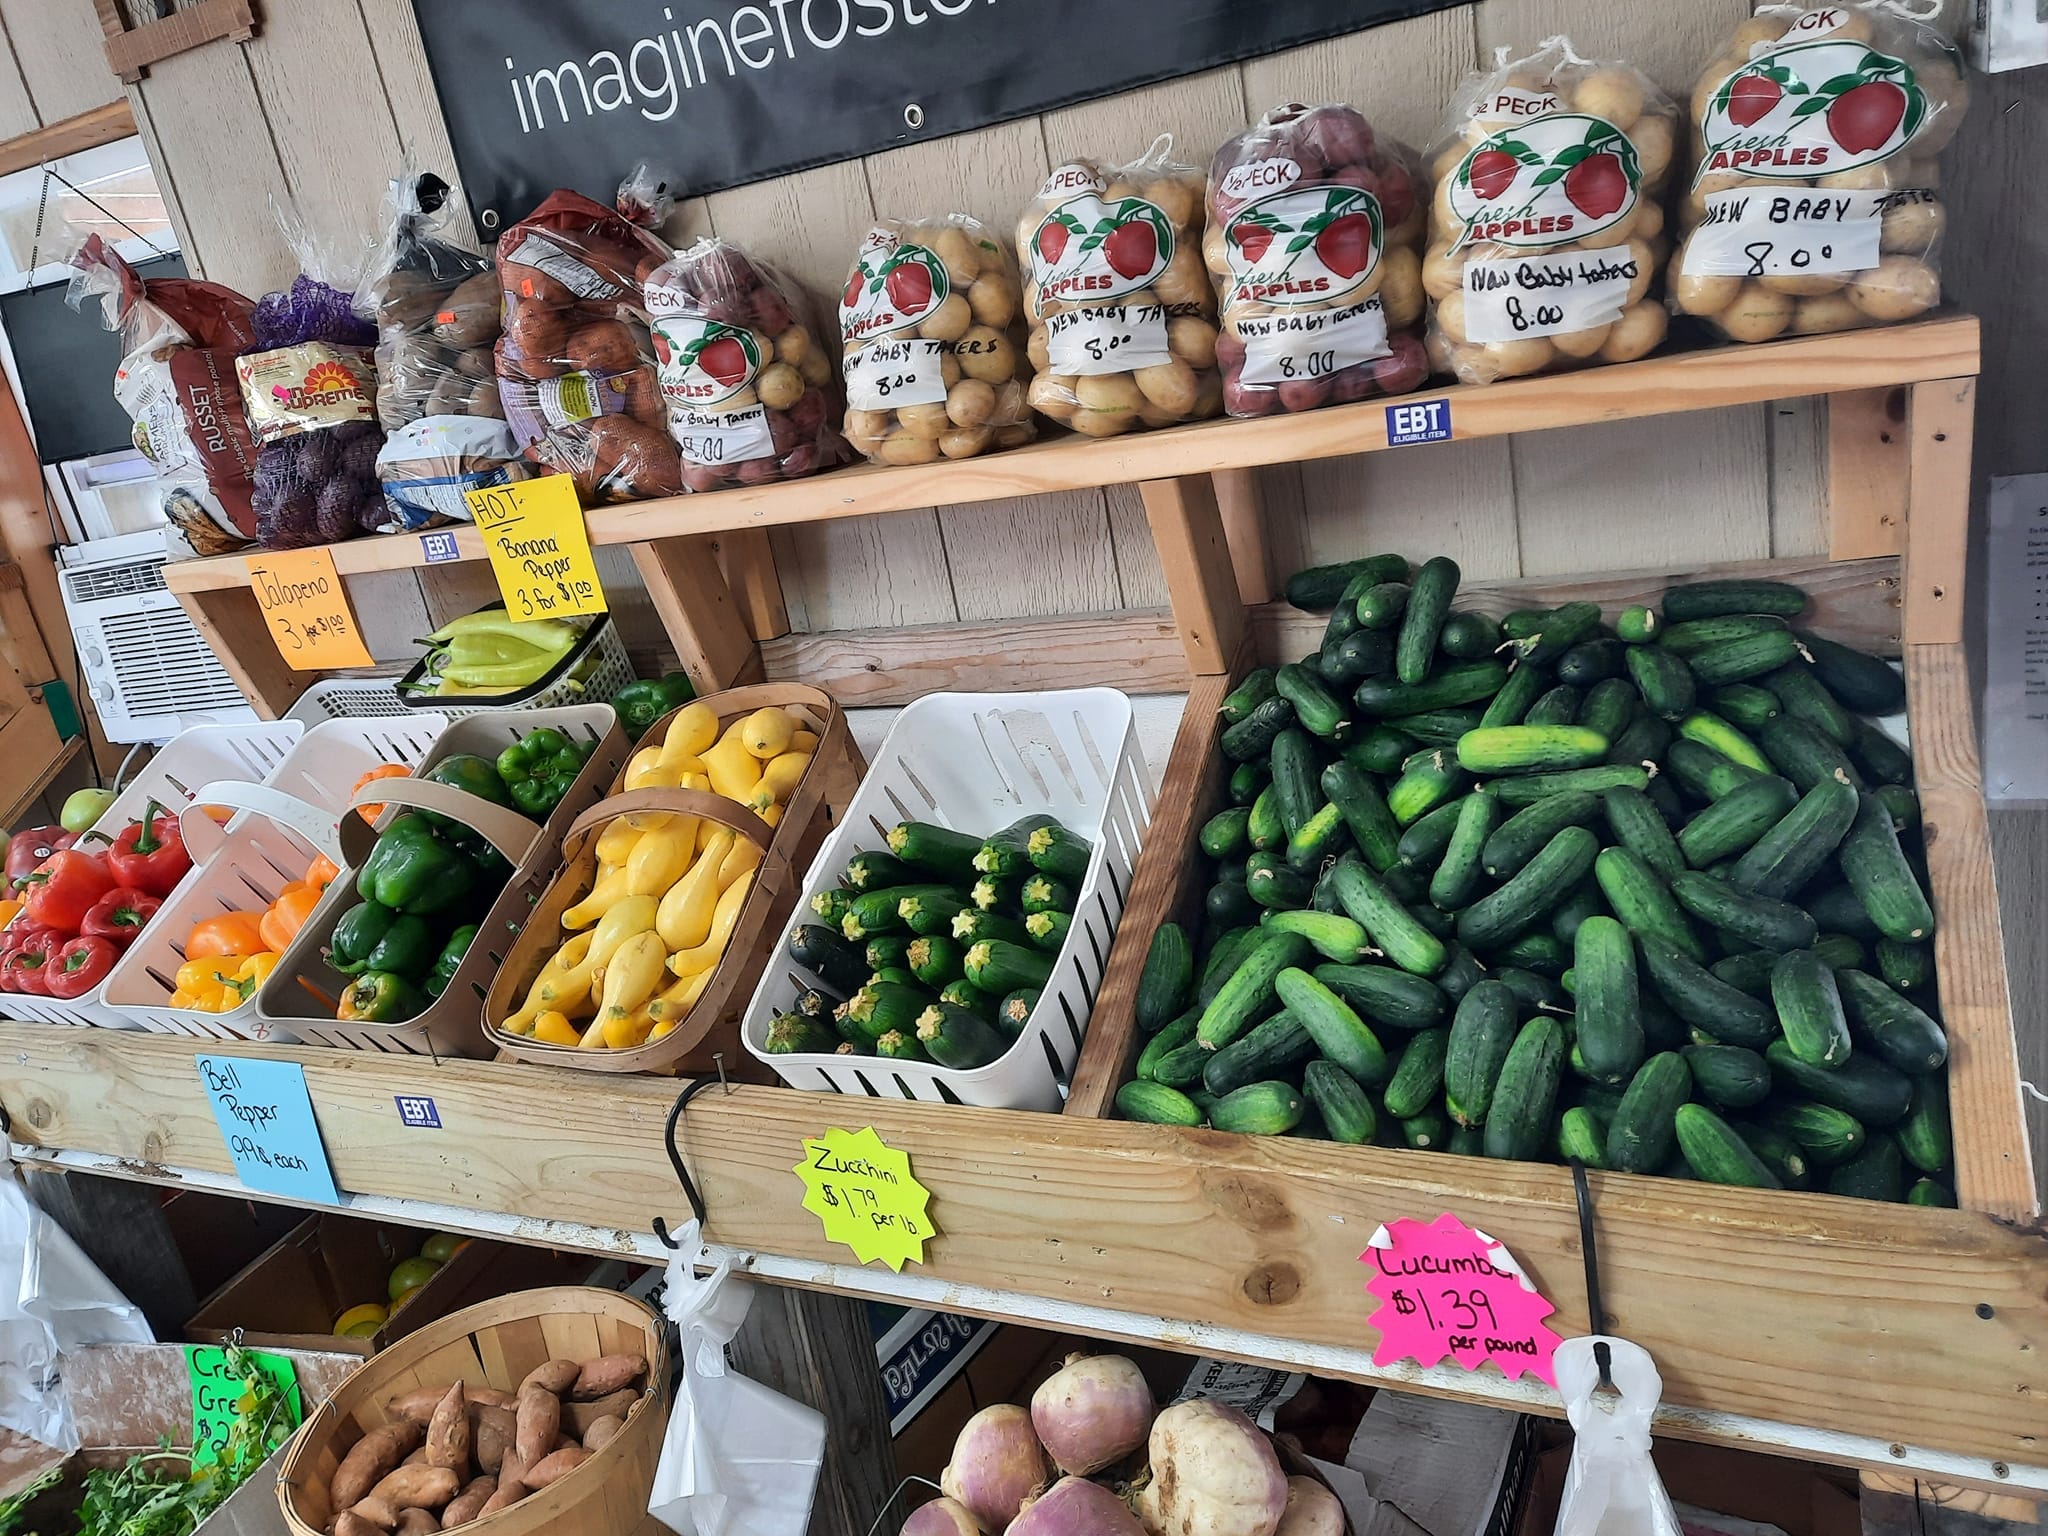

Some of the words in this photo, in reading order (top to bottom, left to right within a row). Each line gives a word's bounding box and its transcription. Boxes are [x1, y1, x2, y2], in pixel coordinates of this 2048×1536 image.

[1495, 95, 1557, 115] PECK
[1708, 147, 1830, 171] APPLES
[1768, 196, 1851, 224] BABY
[1469, 214, 1575, 242] APPLES
[1744, 242, 1833, 277] 8.00
[646, 289, 680, 306] PECK
[1041, 274, 1113, 302] APPLES
[1236, 277, 1331, 300] APPLES
[843, 313, 895, 341] APPLES
[1050, 311, 1079, 338] NEW
[1082, 305, 1128, 323] BABY
[1237, 320, 1271, 337] New
[1084, 334, 1132, 360] 8.00
[1279, 350, 1335, 377] 8.00
[875, 373, 916, 396] 8.00
[189, 384, 228, 453] RUSSET
[1394, 403, 1442, 434] EBT
[231, 437, 248, 466] classic
[425, 534, 452, 555] EBT
[496, 533, 560, 560] Banana
[522, 557, 571, 580] Pepper
[251, 569, 330, 611] Jalapeno
[517, 589, 535, 617] 3
[535, 591, 557, 613] for
[278, 617, 303, 650] 3
[199, 1059, 242, 1092] Bell
[218, 1094, 278, 1133] Pepper
[400, 1098, 432, 1120] EBT
[273, 1153, 309, 1173] each
[810, 1145, 898, 1185] Zucchini
[821, 1182, 878, 1218] $1.79
[870, 1211, 895, 1231] per
[1391, 1288, 1498, 1331] $1.39
[1448, 1335, 1478, 1353] per
[1484, 1336, 1538, 1356] pound
